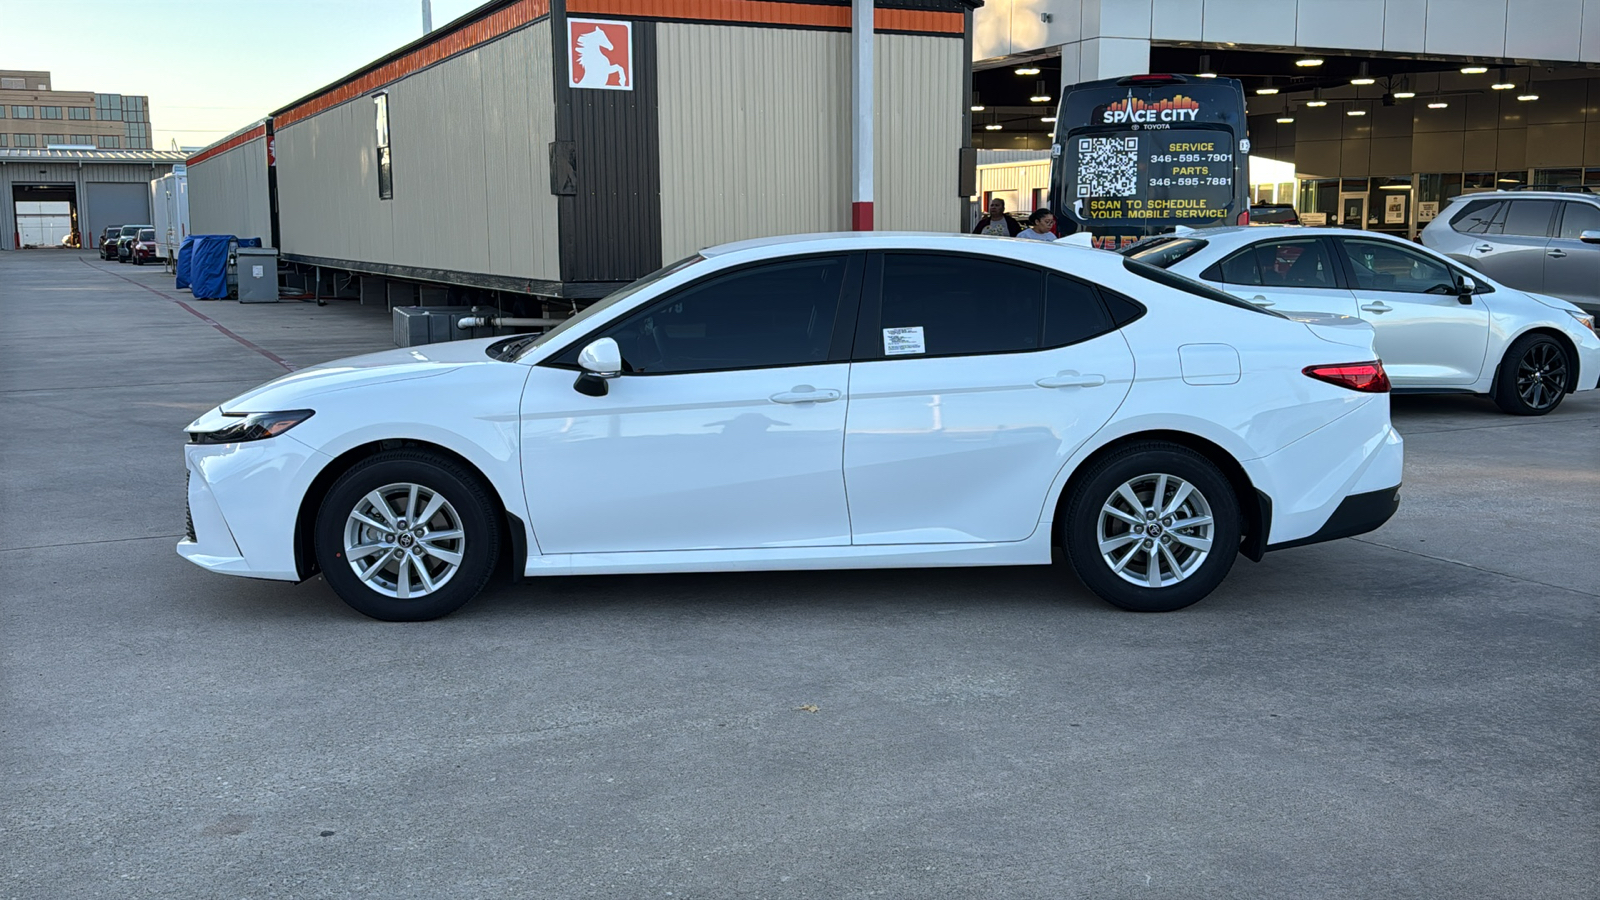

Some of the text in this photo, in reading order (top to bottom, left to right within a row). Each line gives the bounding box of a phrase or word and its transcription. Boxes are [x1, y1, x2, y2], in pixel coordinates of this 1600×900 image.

[1103, 97, 1199, 123] SPACE CITY
[1169, 143, 1214, 151] SERVICE
[1150, 154, 1232, 163] 346-595-7901
[1172, 167, 1208, 175] PARTS
[1149, 178, 1231, 186] 346-595-7881
[1091, 201, 1121, 209] SCAN
[1147, 200, 1206, 208] SCHEDULE
[1091, 209, 1227, 219] YOUR MOBILE SERVICE!
